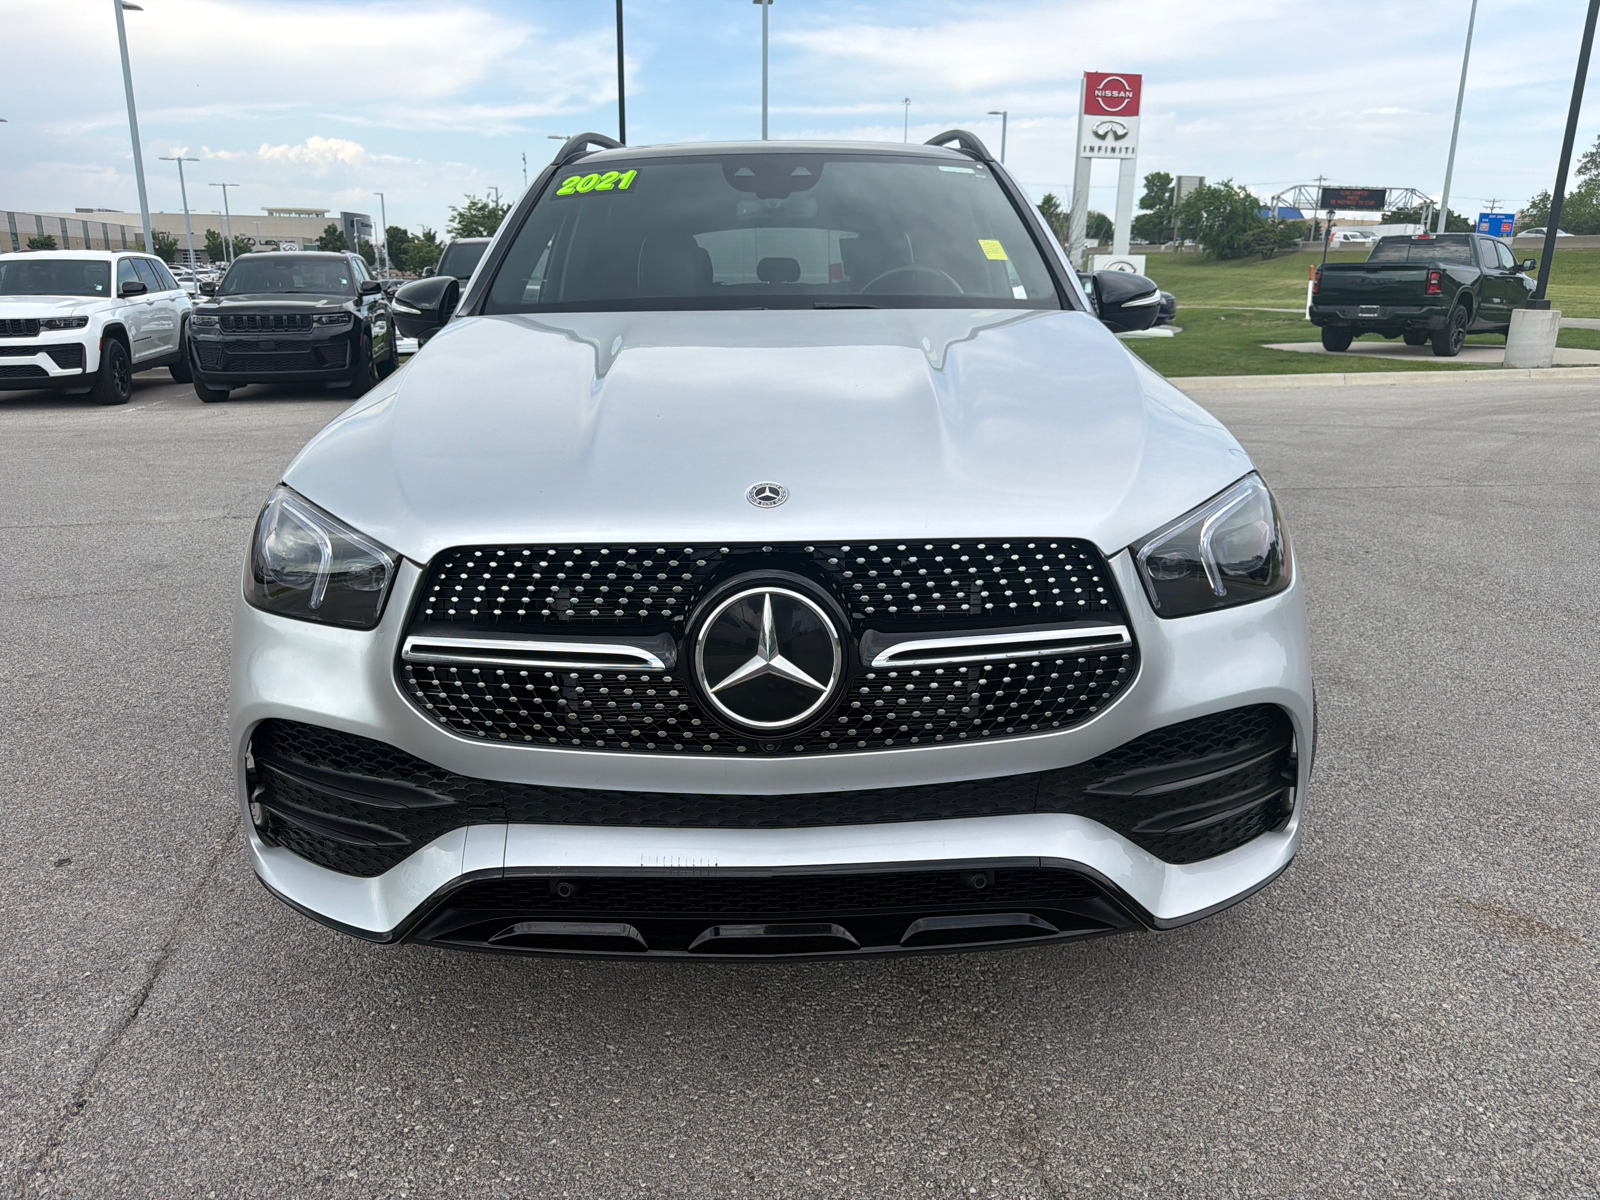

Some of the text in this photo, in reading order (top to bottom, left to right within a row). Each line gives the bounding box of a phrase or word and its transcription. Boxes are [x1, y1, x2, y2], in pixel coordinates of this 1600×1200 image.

[1094, 90, 1133, 98] NISSAN
[1083, 145, 1135, 154] INFINITI
[556, 169, 638, 196] 2021
